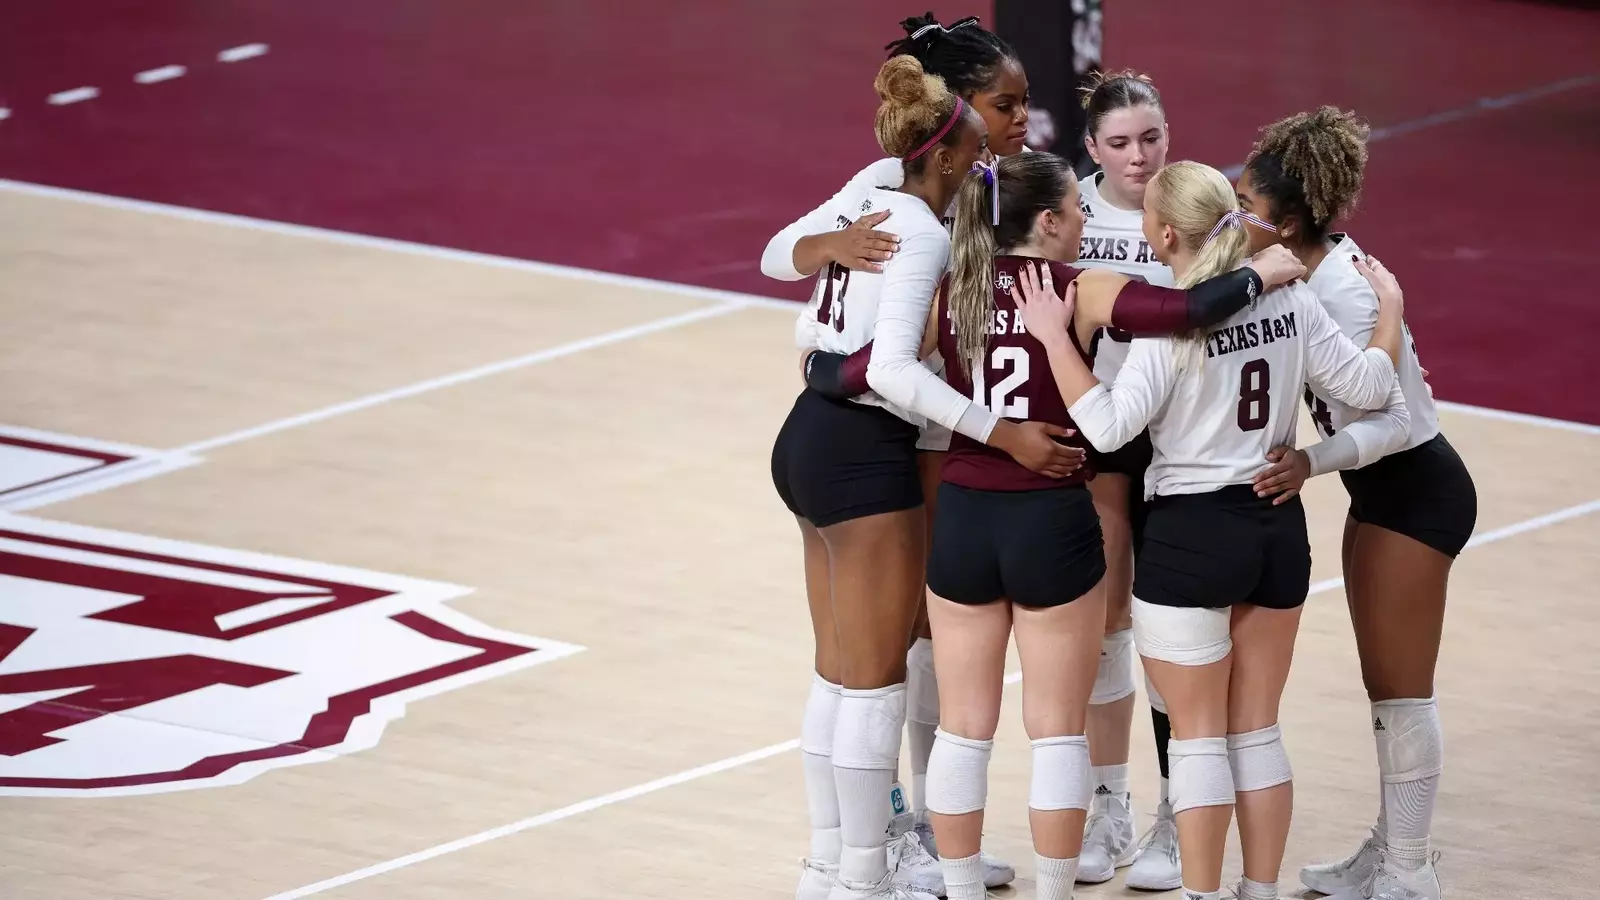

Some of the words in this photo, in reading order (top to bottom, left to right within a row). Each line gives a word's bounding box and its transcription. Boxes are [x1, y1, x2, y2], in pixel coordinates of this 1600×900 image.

[1079, 237, 1129, 261] EXAS
[1206, 321, 1260, 359] TEXAS
[1260, 311, 1298, 345] A&M
[1237, 357, 1270, 432] 8
